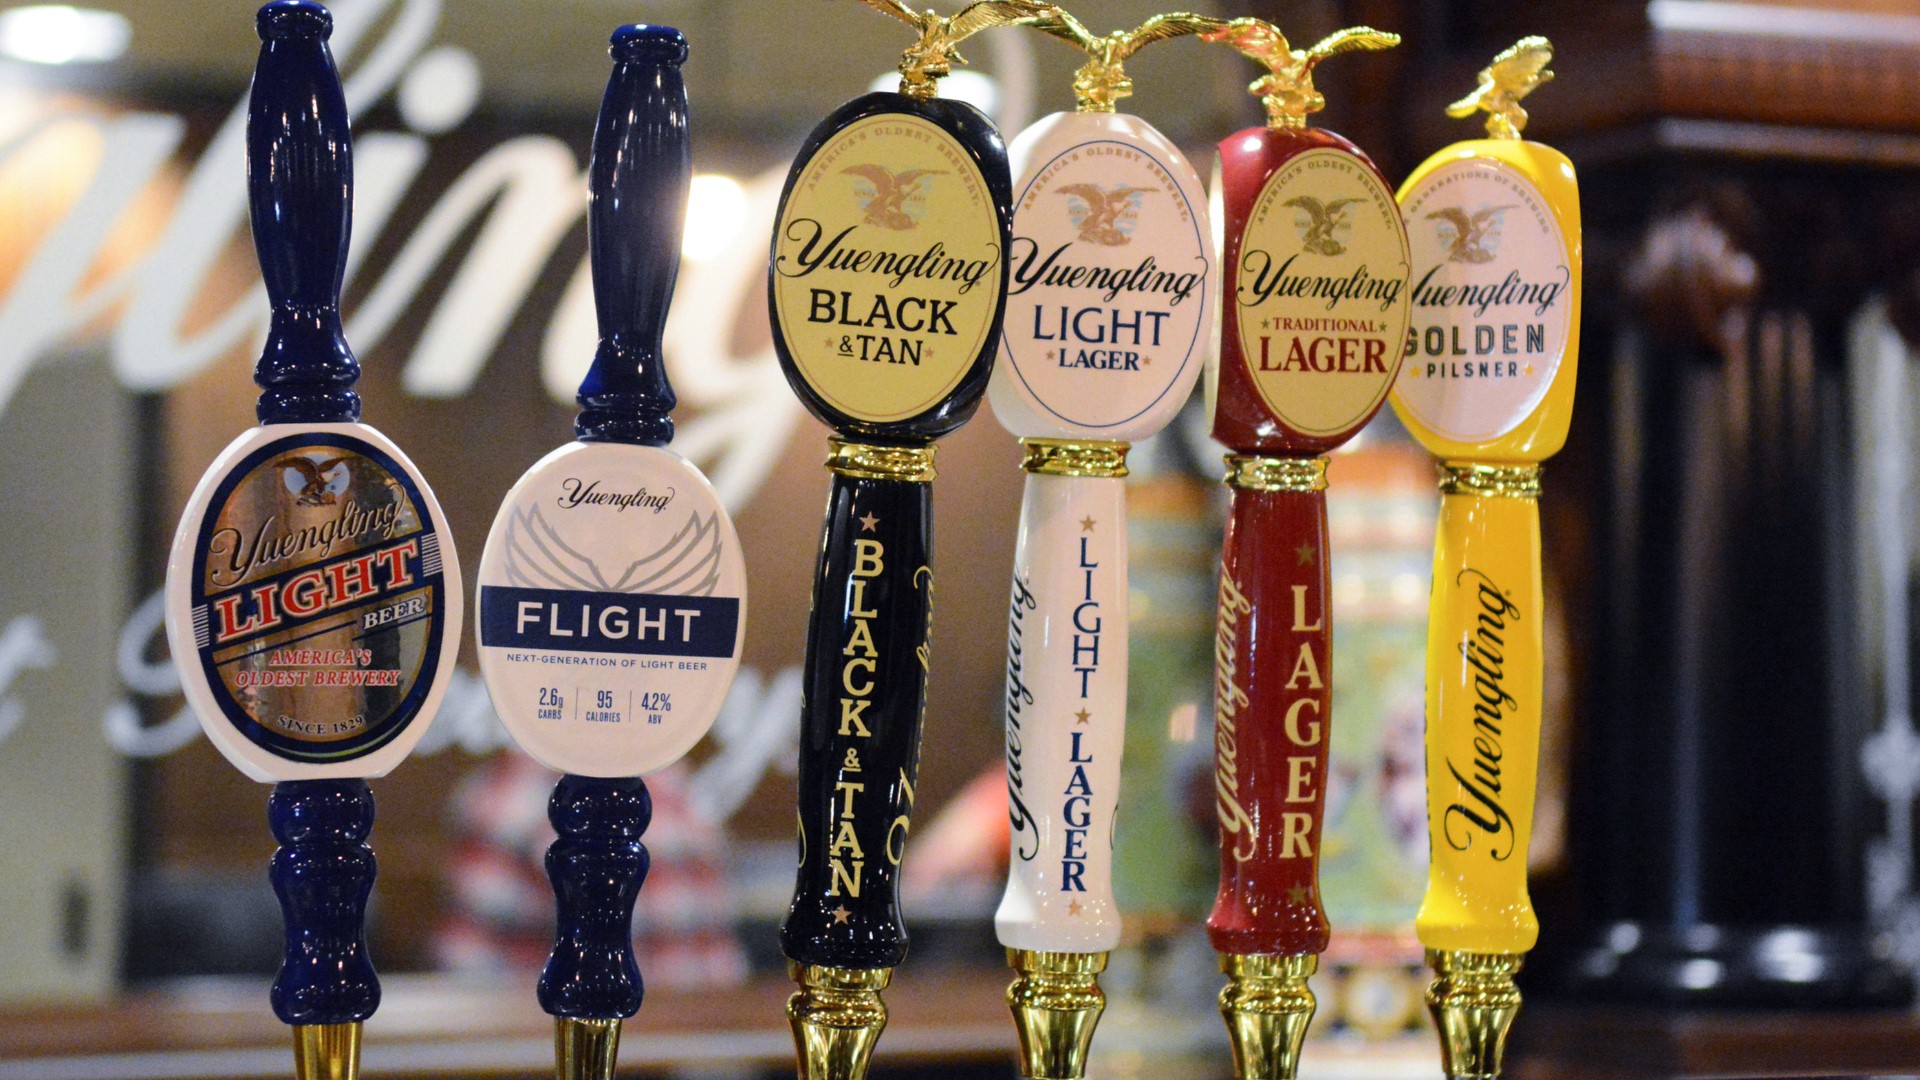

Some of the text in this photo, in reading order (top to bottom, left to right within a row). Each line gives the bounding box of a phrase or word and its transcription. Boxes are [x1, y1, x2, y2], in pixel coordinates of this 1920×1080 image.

[808, 127, 980, 202] AMERICA'S OLDEST BREWERY
[1023, 147, 1189, 218] AMERICA'S OLDEST BREWERY
[1258, 166, 1302, 223] AMERICA'S
[1308, 160, 1352, 174] OLDEST
[775, 218, 1001, 294] Yuengling
[1007, 237, 1209, 306] Yuengling
[1236, 249, 1410, 311] Yuengling
[808, 287, 958, 335] BLACK
[1033, 304, 1171, 346] LIGHT
[1273, 317, 1378, 333] TRADITIONAL
[1059, 348, 1140, 371] LAGER
[1259, 336, 1388, 374] LAGER
[1427, 361, 1518, 378] PILSNER
[557, 478, 675, 514] Yuengling
[208, 483, 407, 587] Yuengling
[215, 541, 417, 644] LIGHT
[362, 597, 426, 630] BEER
[516, 600, 701, 643] FLIGHT
[268, 649, 373, 666] AMERICA'S
[506, 653, 708, 671] NEXT-GENERATION OF LIGHT BEER
[235, 669, 401, 687] OLDEST BREWERY
[537, 708, 562, 720] CARBS
[538, 686, 564, 709] 2.6g
[585, 710, 621, 723] CALORIES
[596, 690, 613, 710] 95
[641, 692, 671, 713] 4.2%
[1060, 537, 1102, 891] LIGHT LAGER
[1444, 568, 1521, 861] Yuengling
[277, 714, 365, 735] SINCE 1829
[647, 713, 662, 725] ABV
[829, 538, 885, 898] BLACK & TAN
[1279, 584, 1324, 859] LAGER
